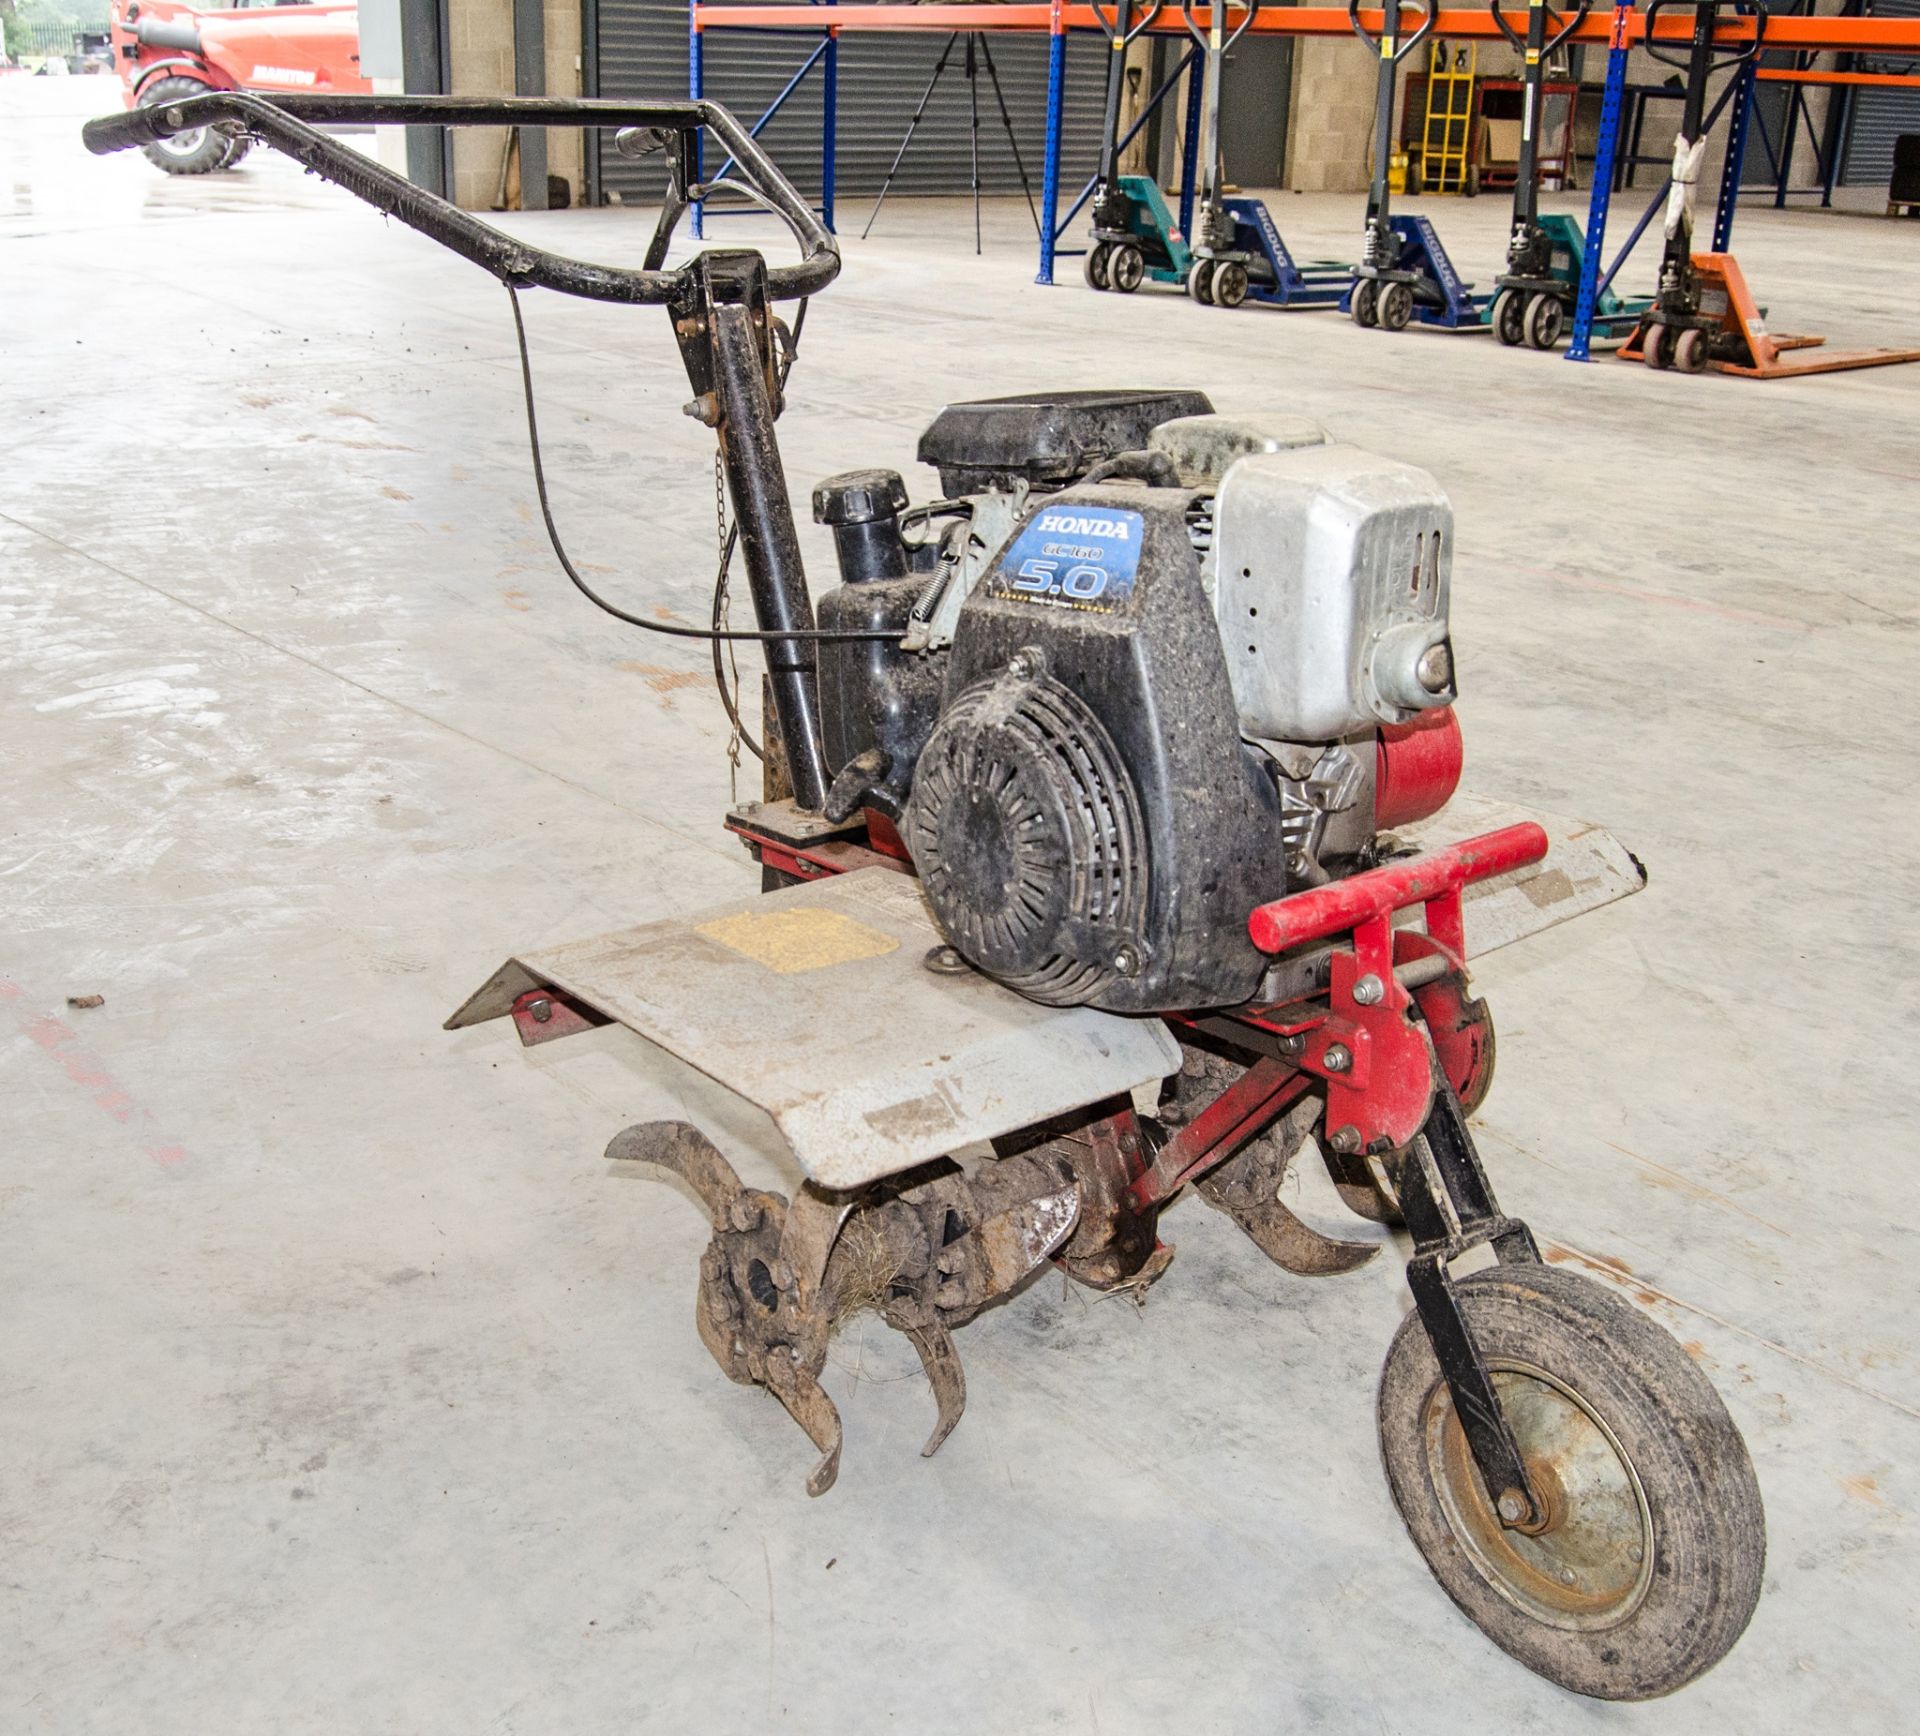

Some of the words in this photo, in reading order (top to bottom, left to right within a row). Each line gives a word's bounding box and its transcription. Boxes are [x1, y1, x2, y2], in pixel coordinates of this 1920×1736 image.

[1256, 206, 1288, 268] BIGDUG
[1421, 223, 1455, 288] BIGDUG
[1038, 515, 1129, 540] HONDA
[1042, 542, 1104, 560] GC160
[1012, 558, 1108, 599] 5.0
